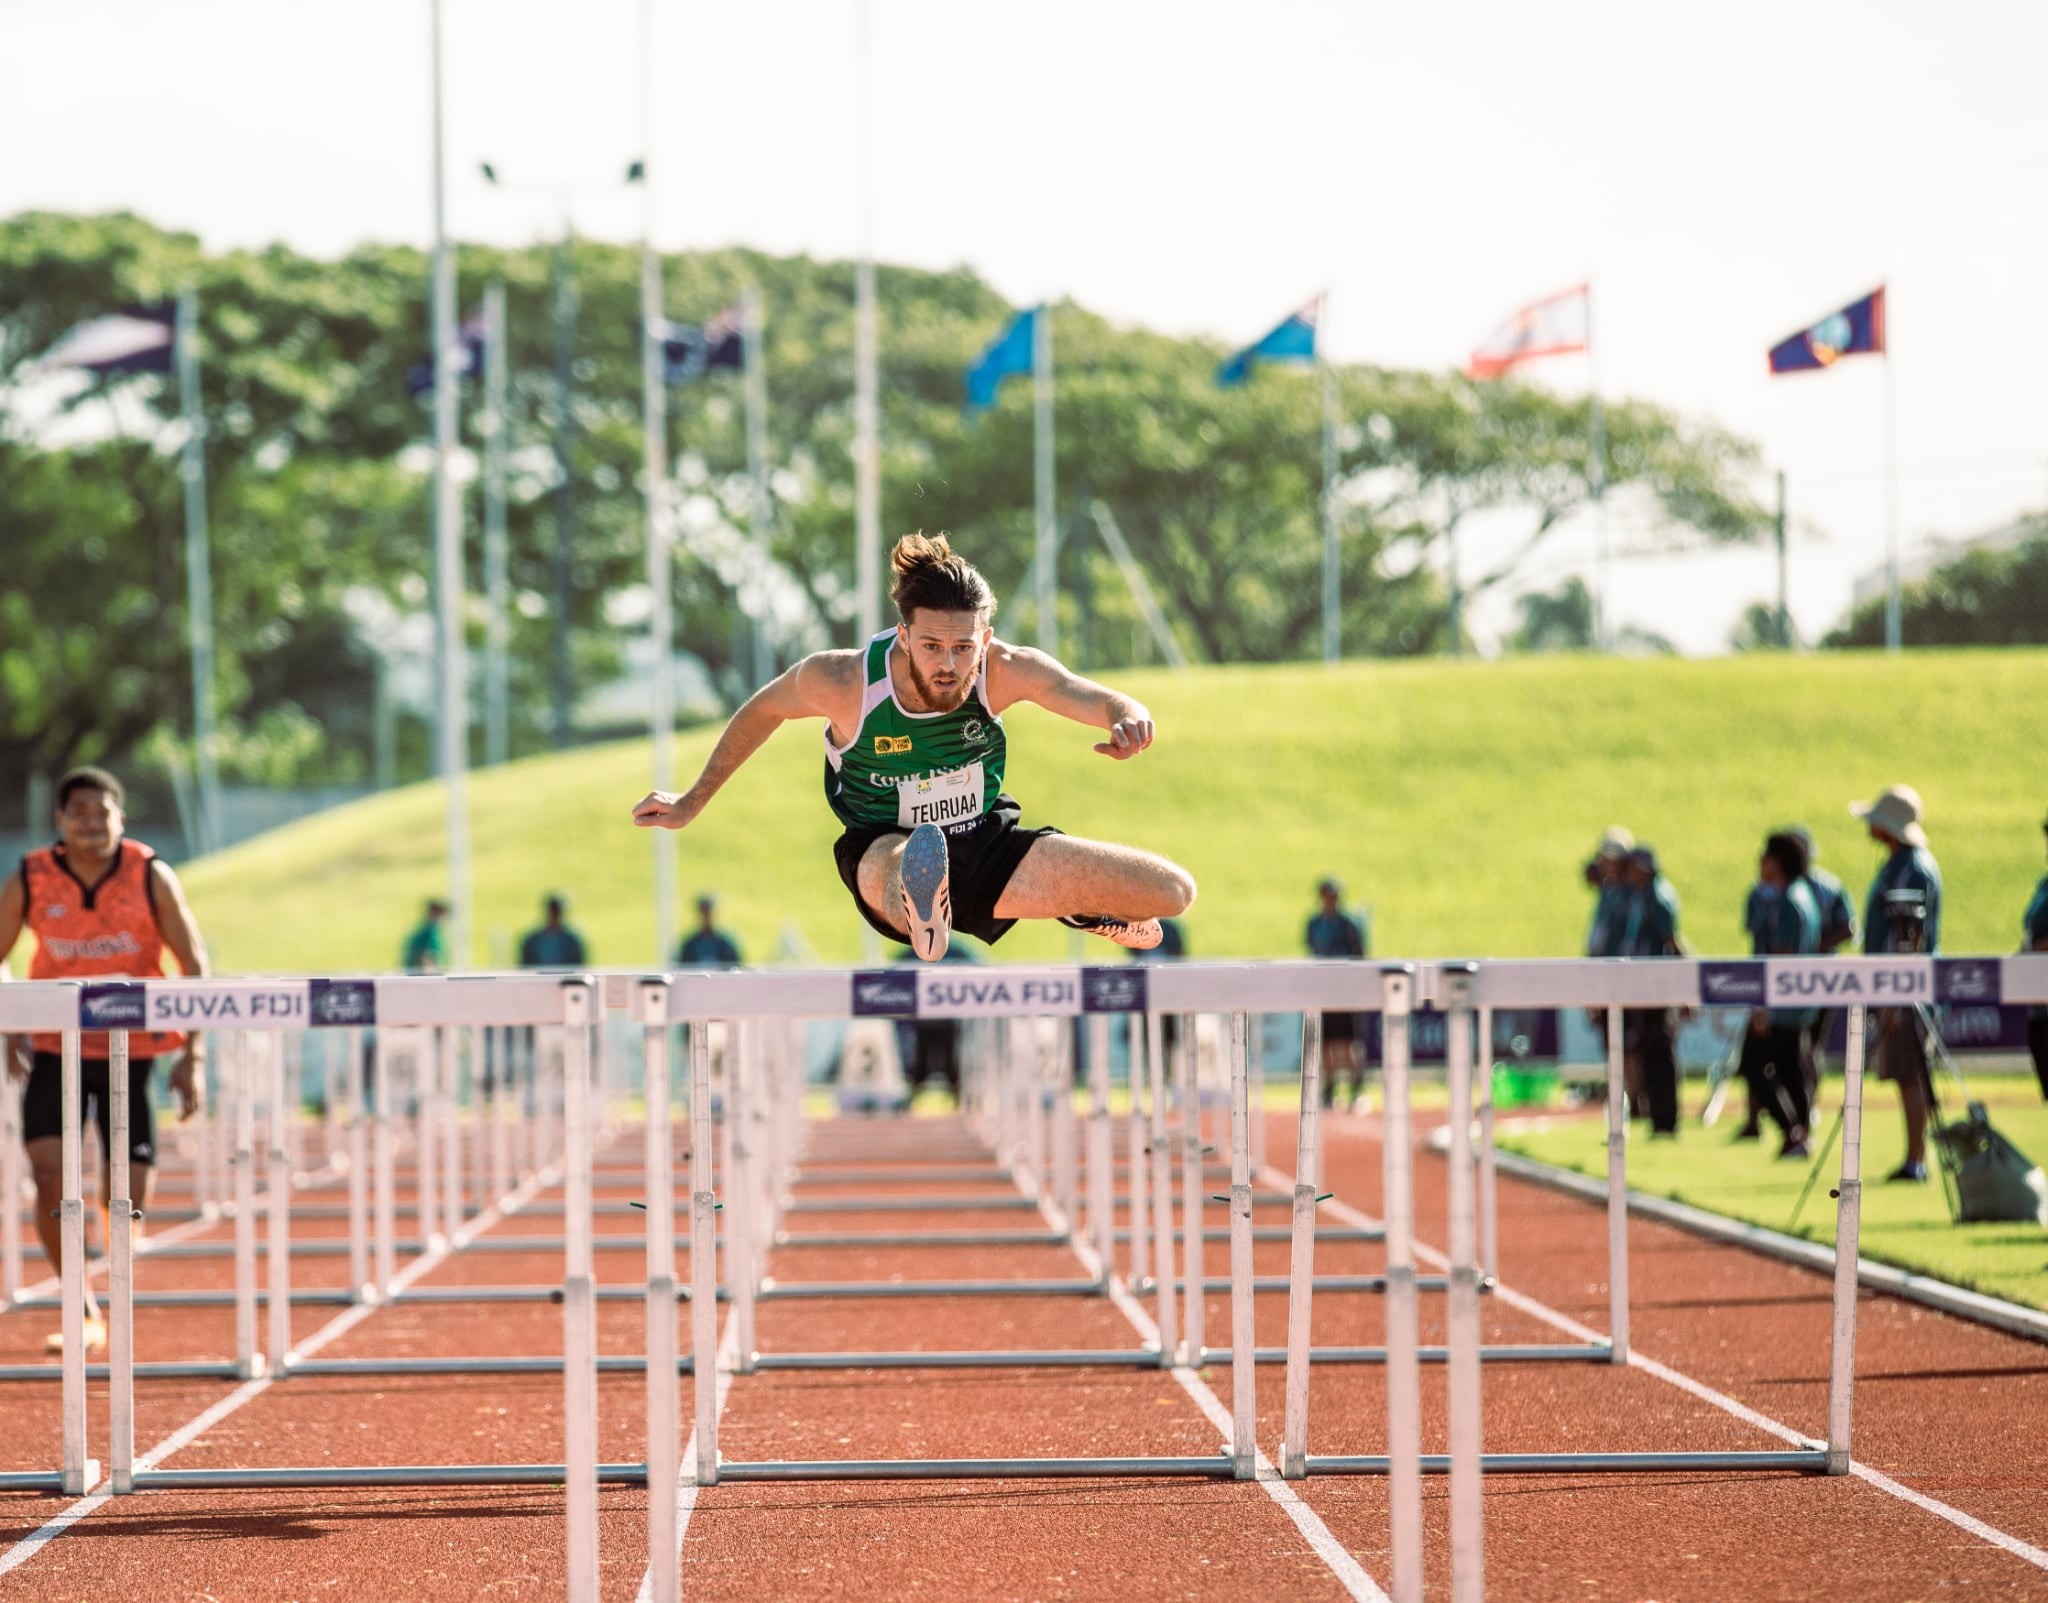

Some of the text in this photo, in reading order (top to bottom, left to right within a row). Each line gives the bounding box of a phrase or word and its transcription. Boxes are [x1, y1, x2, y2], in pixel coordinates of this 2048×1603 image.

[911, 792, 977, 824] TEURUAA
[949, 823, 966, 835] FIJI
[927, 980, 1013, 1006] SUVA
[1023, 979, 1075, 1004] FIJI
[1775, 970, 1863, 996] SUVA
[1872, 969, 1927, 994] FIJI
[154, 993, 240, 1019] SUVA
[250, 992, 303, 1017] FIJI
